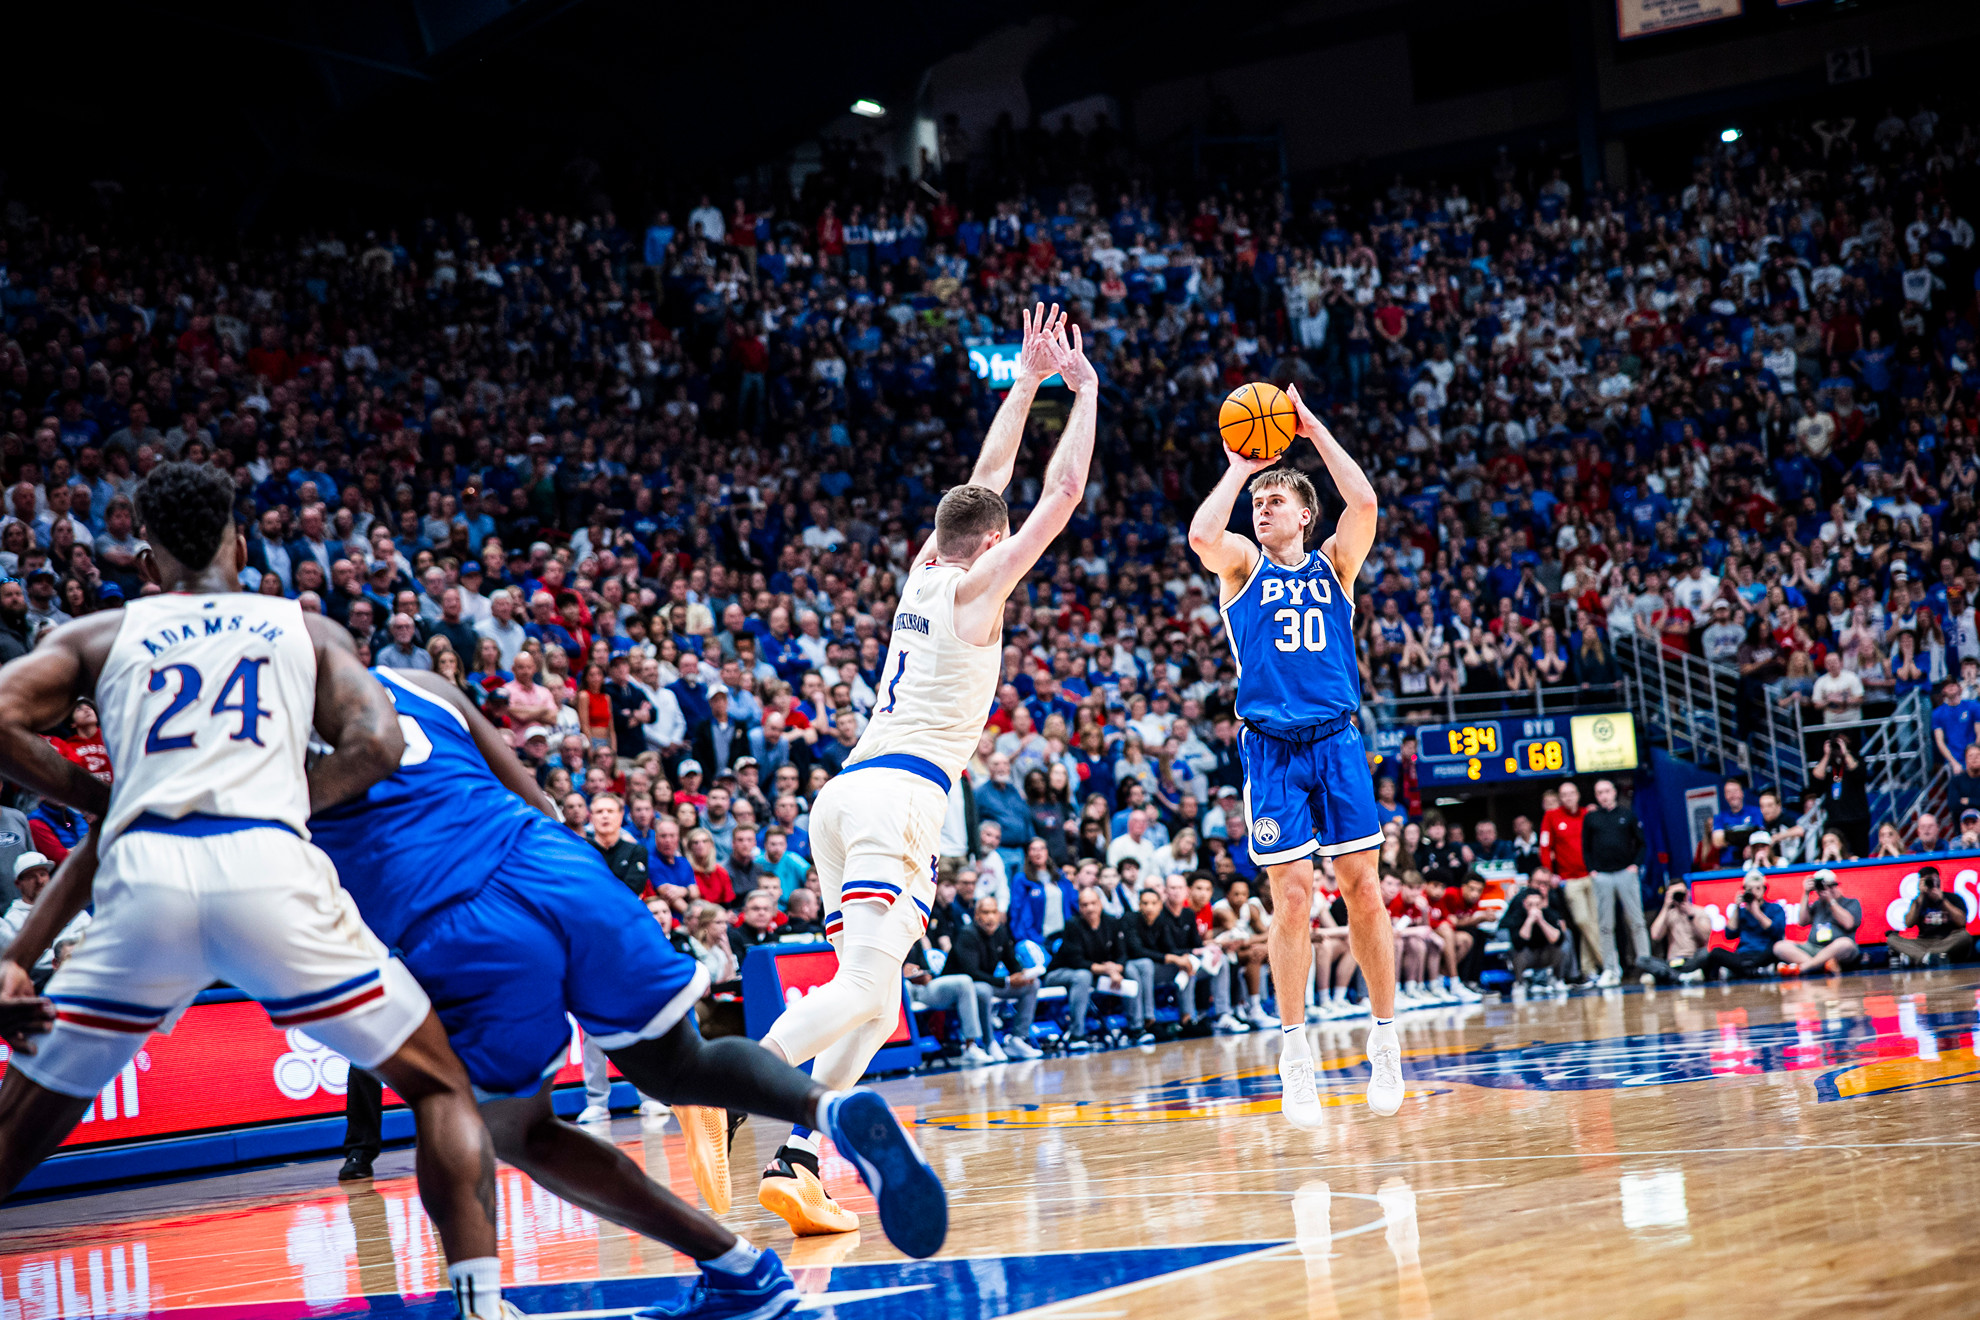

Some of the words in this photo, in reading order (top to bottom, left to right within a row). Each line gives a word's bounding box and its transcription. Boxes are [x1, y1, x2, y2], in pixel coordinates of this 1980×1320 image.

[1260, 578, 1332, 607] BYU
[142, 615, 243, 658] ADAMS
[1274, 607, 1327, 653] 30
[879, 650, 910, 713] 1
[145, 655, 273, 756] 24
[1448, 727, 1497, 755] 1:34
[1528, 741, 1563, 771] 68
[1467, 758, 1482, 780] 2
